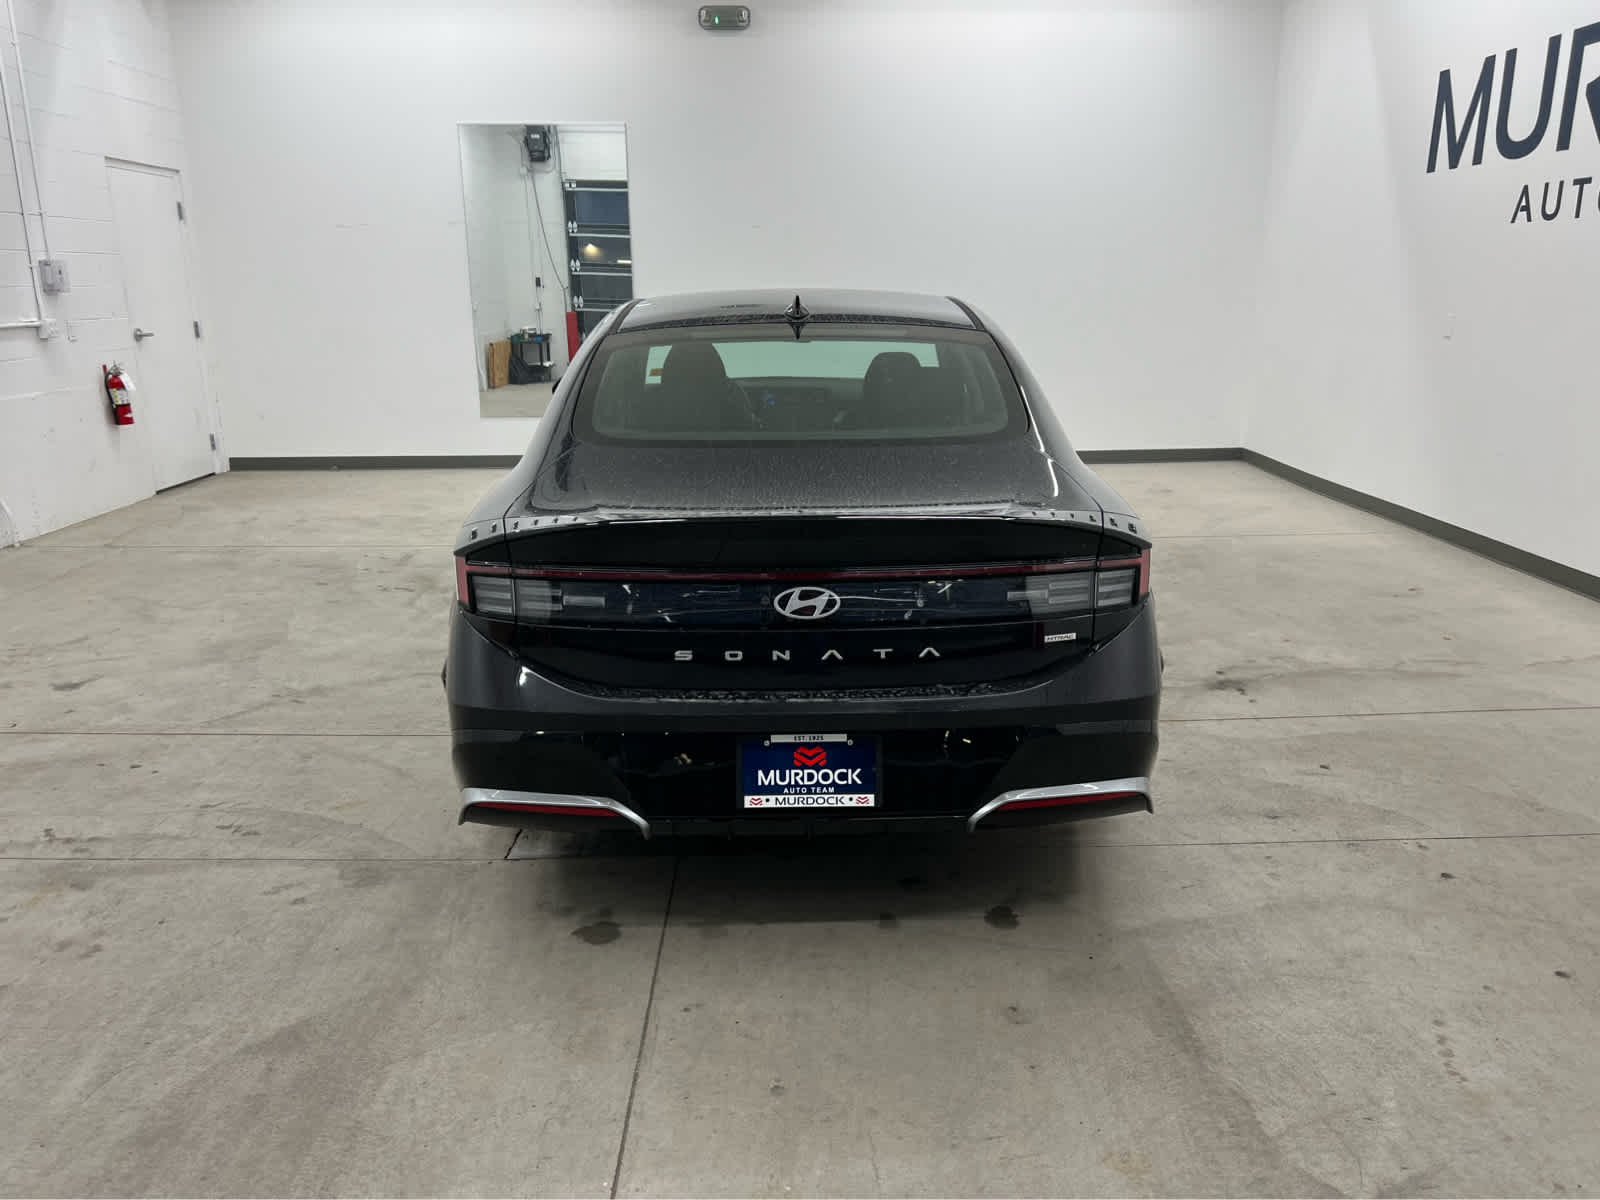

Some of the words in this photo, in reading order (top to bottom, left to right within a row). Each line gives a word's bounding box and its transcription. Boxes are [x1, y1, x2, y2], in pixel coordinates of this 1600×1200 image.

[1510, 176, 1600, 224] AUT
[674, 647, 940, 661] SONATA
[757, 768, 862, 786] MURDOCK
[775, 796, 845, 806] MURDOCK
